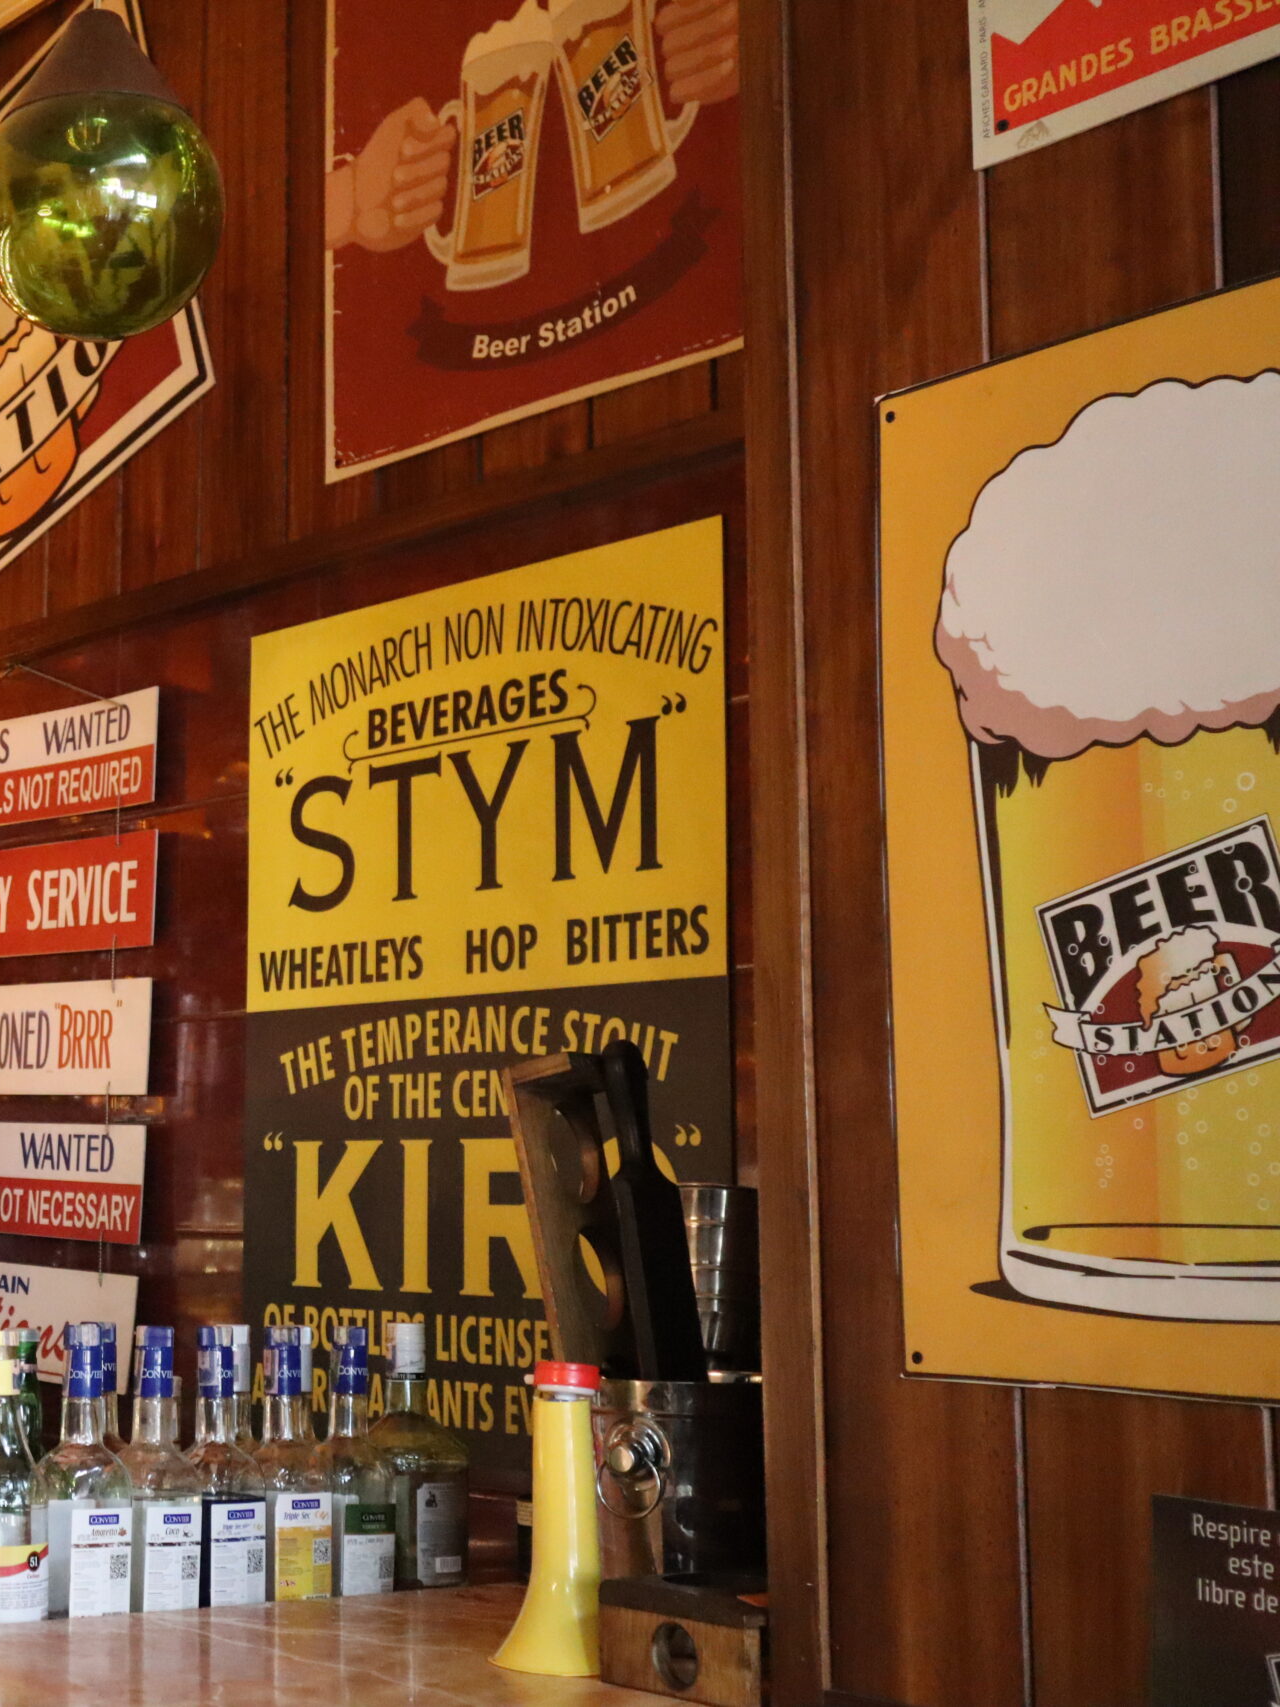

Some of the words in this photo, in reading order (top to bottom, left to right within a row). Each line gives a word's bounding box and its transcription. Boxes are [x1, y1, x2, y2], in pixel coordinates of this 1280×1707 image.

[578, 40, 638, 119] BEER
[1004, 38, 1135, 112] GRANDES
[1150, 0, 1280, 54] BRASS
[473, 113, 524, 171] BEER
[472, 334, 531, 359] Beer
[538, 285, 638, 348] Station
[254, 692, 307, 760] THE
[308, 621, 433, 726] MONARCH
[443, 603, 506, 666] NON
[516, 596, 719, 675] INTOXICATING
[43, 703, 130, 756] WANTED
[367, 668, 569, 751] BEVERAGES
[18, 772, 54, 811] NOT
[57, 756, 142, 806] REQUIRED
[26, 860, 138, 931] SERVICE
[259, 935, 424, 993] WHEATLEYS
[465, 923, 538, 976] HOP
[566, 905, 710, 966] BITTERS
[1050, 841, 1280, 1012] BEER
[280, 1036, 336, 1096] THE
[341, 1005, 551, 1074] TEMPERANCE
[343, 1073, 380, 1121] OF
[389, 1071, 442, 1120] THE
[452, 1070, 511, 1117] CEN
[20, 1132, 114, 1172] WANTED
[27, 1189, 135, 1232] NECESSARY
[436, 1314, 551, 1369] LICENSE
[69, 1368, 103, 1379] CONVIE
[505, 1384, 534, 1437] EV
[284, 1511, 299, 1520] Triple
[300, 1511, 310, 1519] Sec
[1192, 1513, 1271, 1548] Respire
[29, 1555, 38, 1568] 51
[1228, 1554, 1274, 1580] este
[1197, 1577, 1246, 1608] libre
[1253, 1588, 1278, 1614] de
